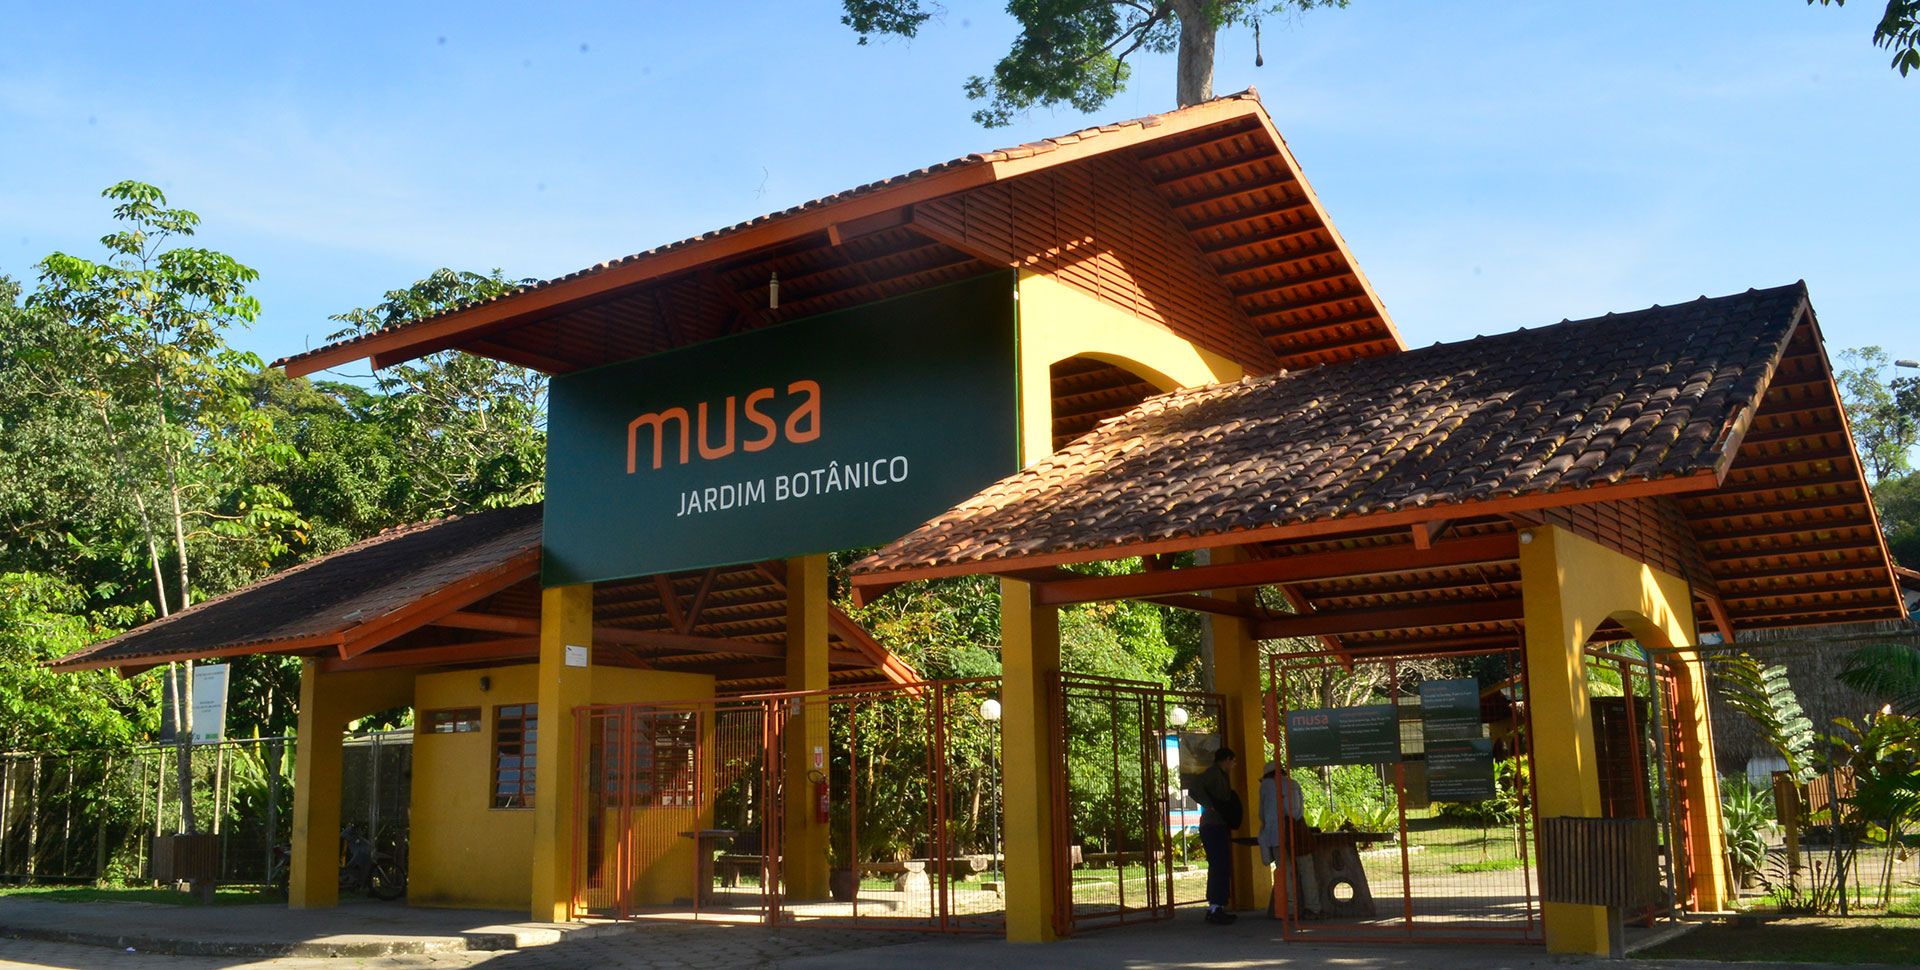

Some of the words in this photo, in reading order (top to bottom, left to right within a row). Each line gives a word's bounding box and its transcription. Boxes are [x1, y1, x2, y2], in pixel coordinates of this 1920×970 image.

[627, 379, 821, 474] musa
[676, 479, 766, 517] JARDIM
[775, 455, 909, 501] BOTÂNICO
[1292, 714, 1329, 726] musa
